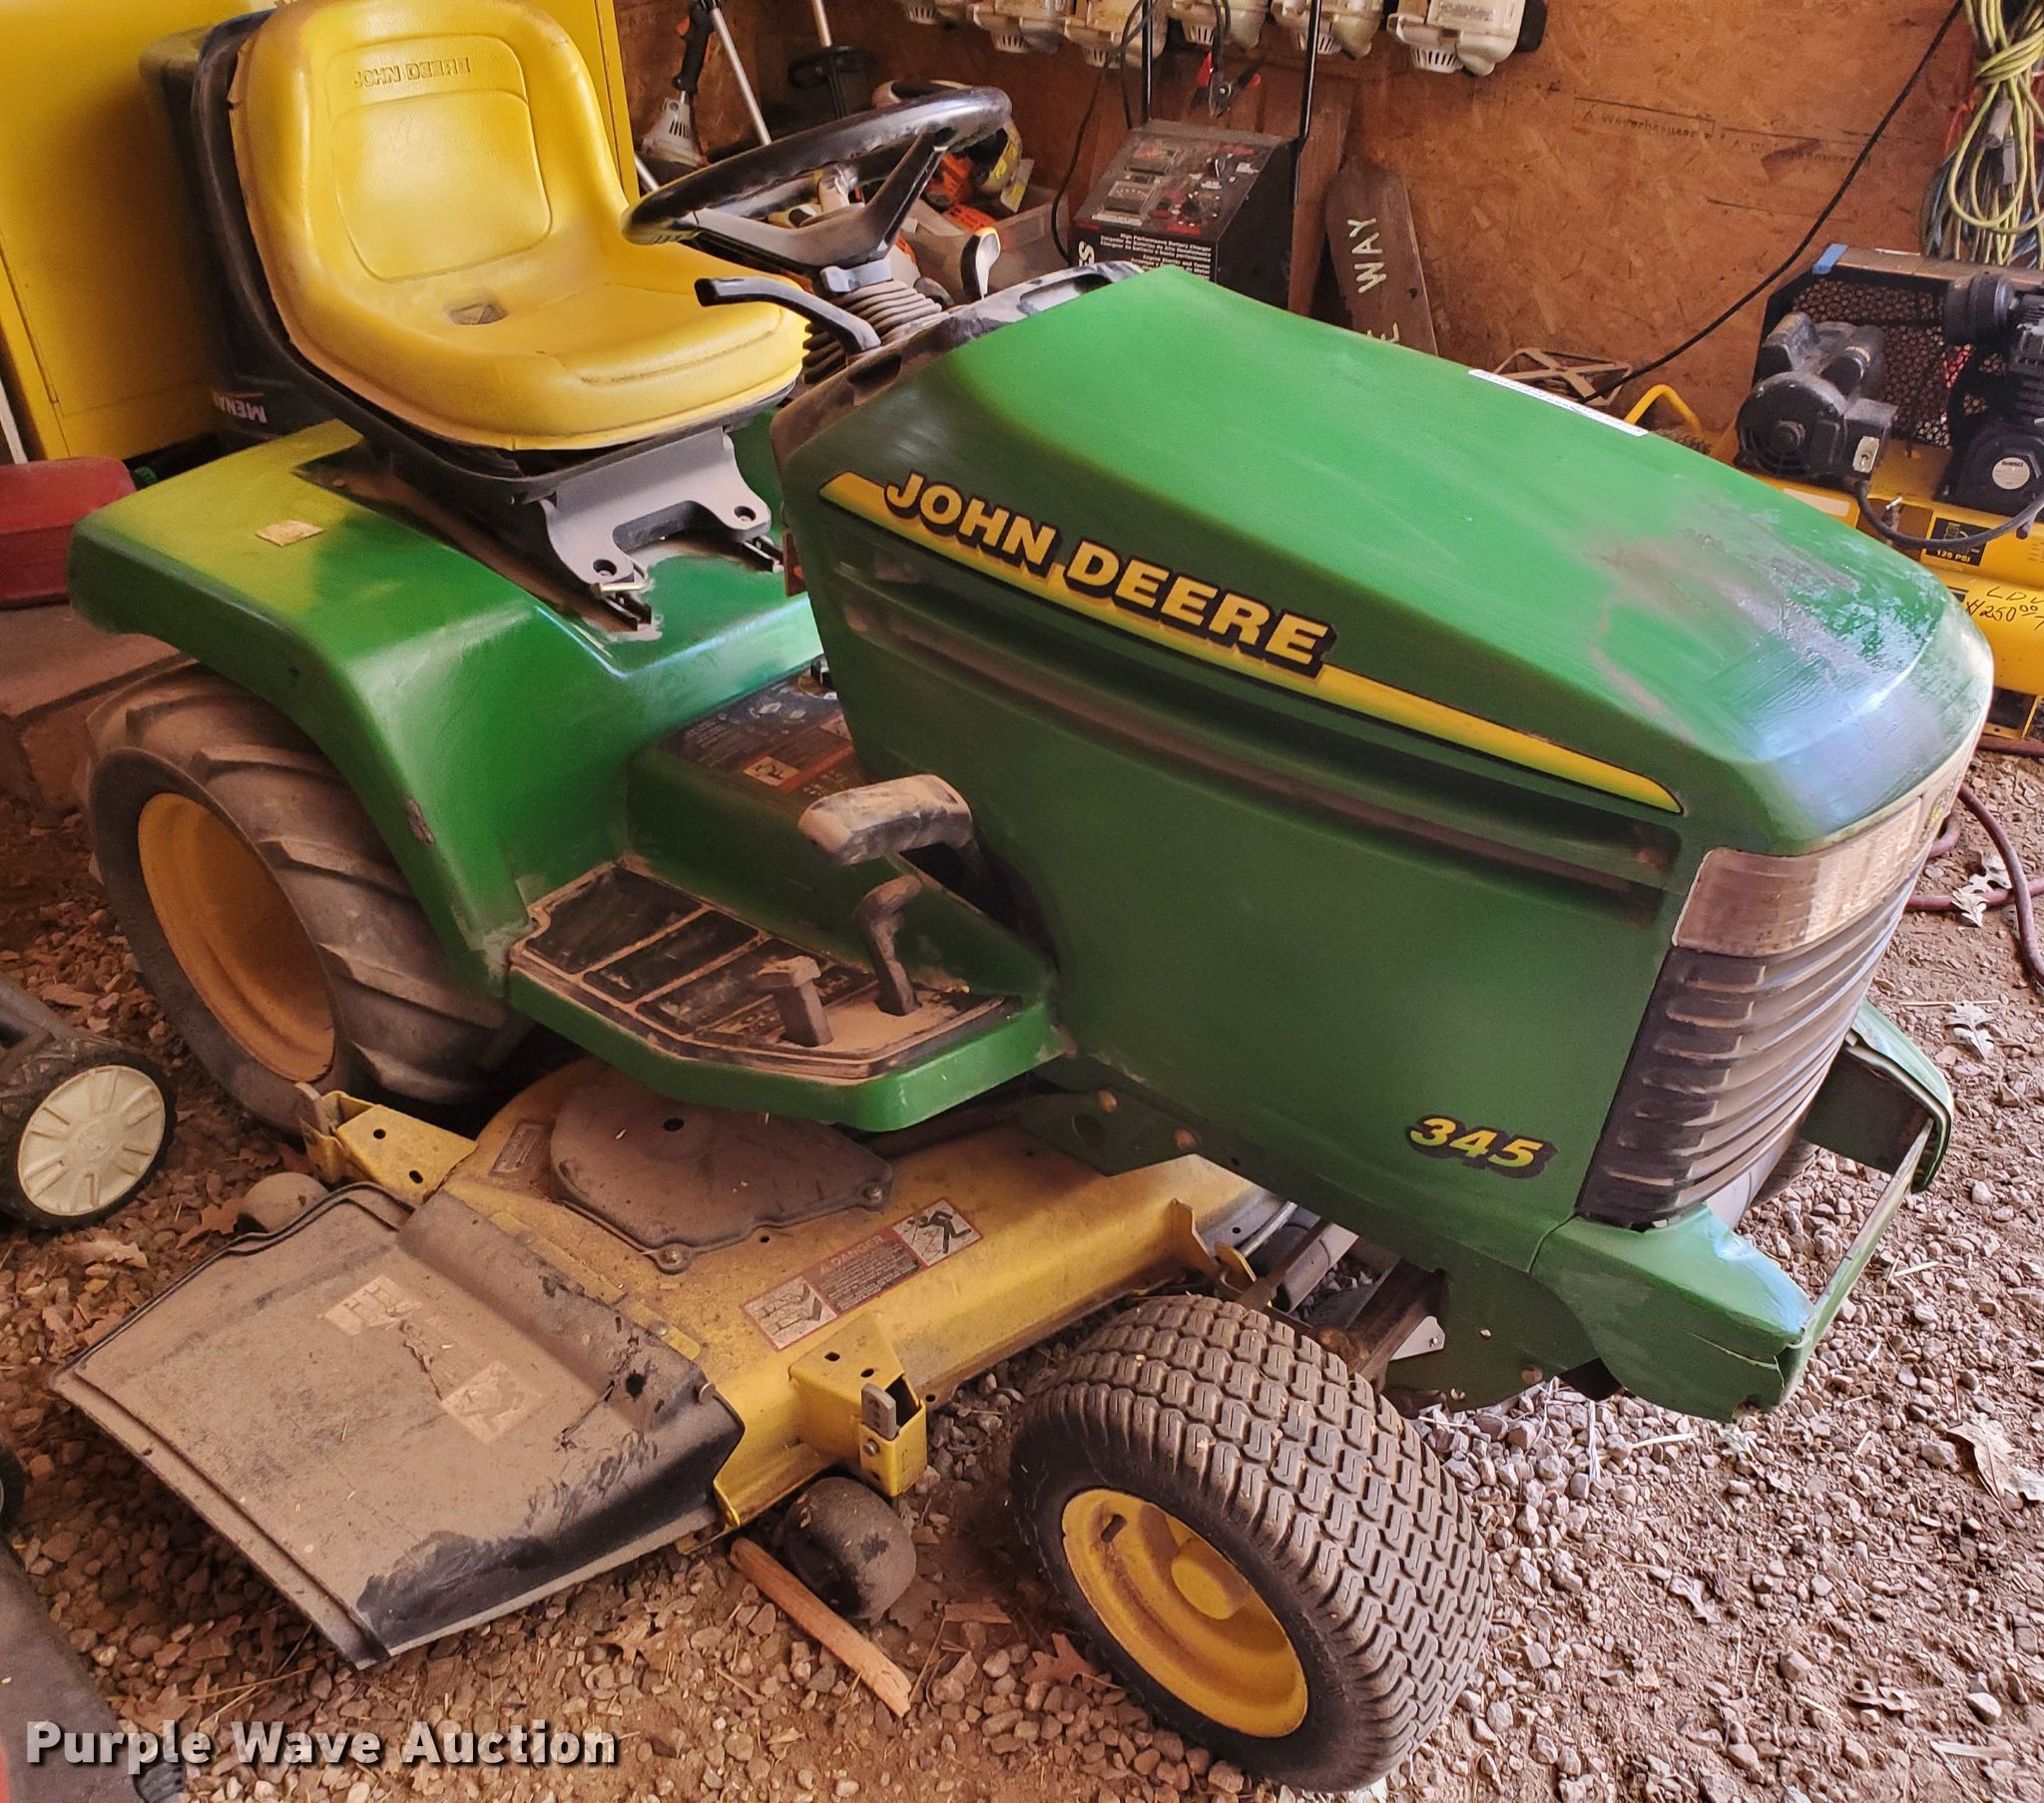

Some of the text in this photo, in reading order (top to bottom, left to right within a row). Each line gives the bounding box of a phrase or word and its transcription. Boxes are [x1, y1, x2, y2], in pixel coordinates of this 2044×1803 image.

[352, 57, 471, 89] JOHN DEERE
[1346, 217, 1387, 293] WAY
[883, 470, 1334, 670] JOHN DEERE
[1408, 1116, 1548, 1171] 345
